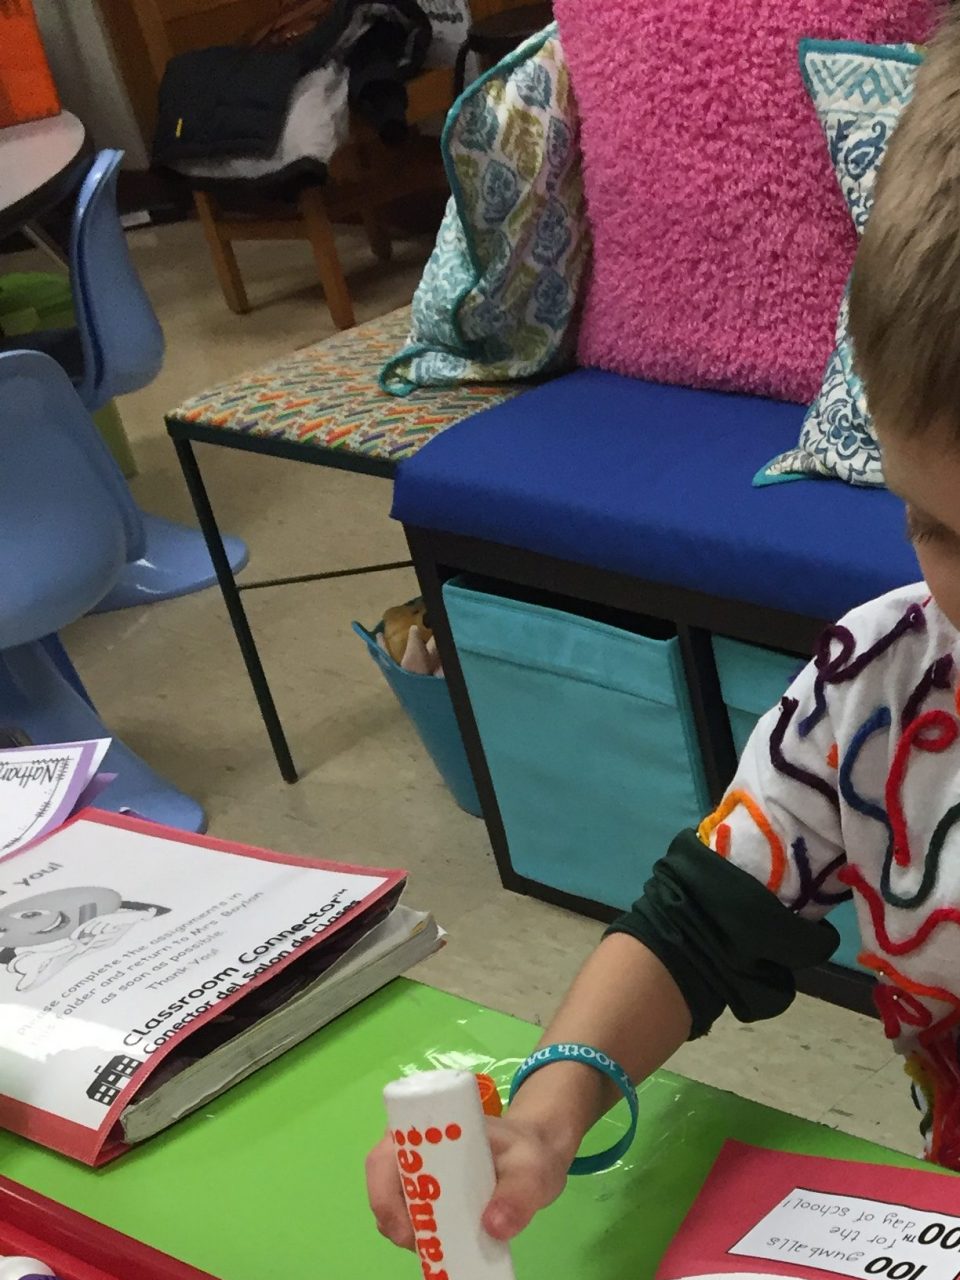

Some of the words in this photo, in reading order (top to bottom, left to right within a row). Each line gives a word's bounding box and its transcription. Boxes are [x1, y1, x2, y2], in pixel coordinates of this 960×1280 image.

[13, 862, 63, 887] you!
[17, 1000, 62, 1036] Plse
[61, 959, 122, 998] complete
[122, 943, 147, 959] the
[150, 902, 228, 945] assignments
[230, 892, 243, 902] in
[100, 970, 125, 988] and
[128, 945, 173, 971] return
[172, 935, 189, 946] to
[101, 992, 117, 1005] as
[119, 970, 151, 992] soon
[152, 960, 168, 973] as
[145, 967, 187, 991] Thank
[143, 1000, 215, 1055] Conector
[216, 982, 243, 1001] del
[242, 950, 291, 980] Salon
[292, 933, 313, 949] de
[123, 967, 240, 1047] Classroom
[853, 1210, 875, 1224] of
[883, 1211, 916, 1233] day
[829, 1226, 860, 1242] the
[866, 1232, 897, 1251] for
[766, 1237, 865, 1263] gumballs
